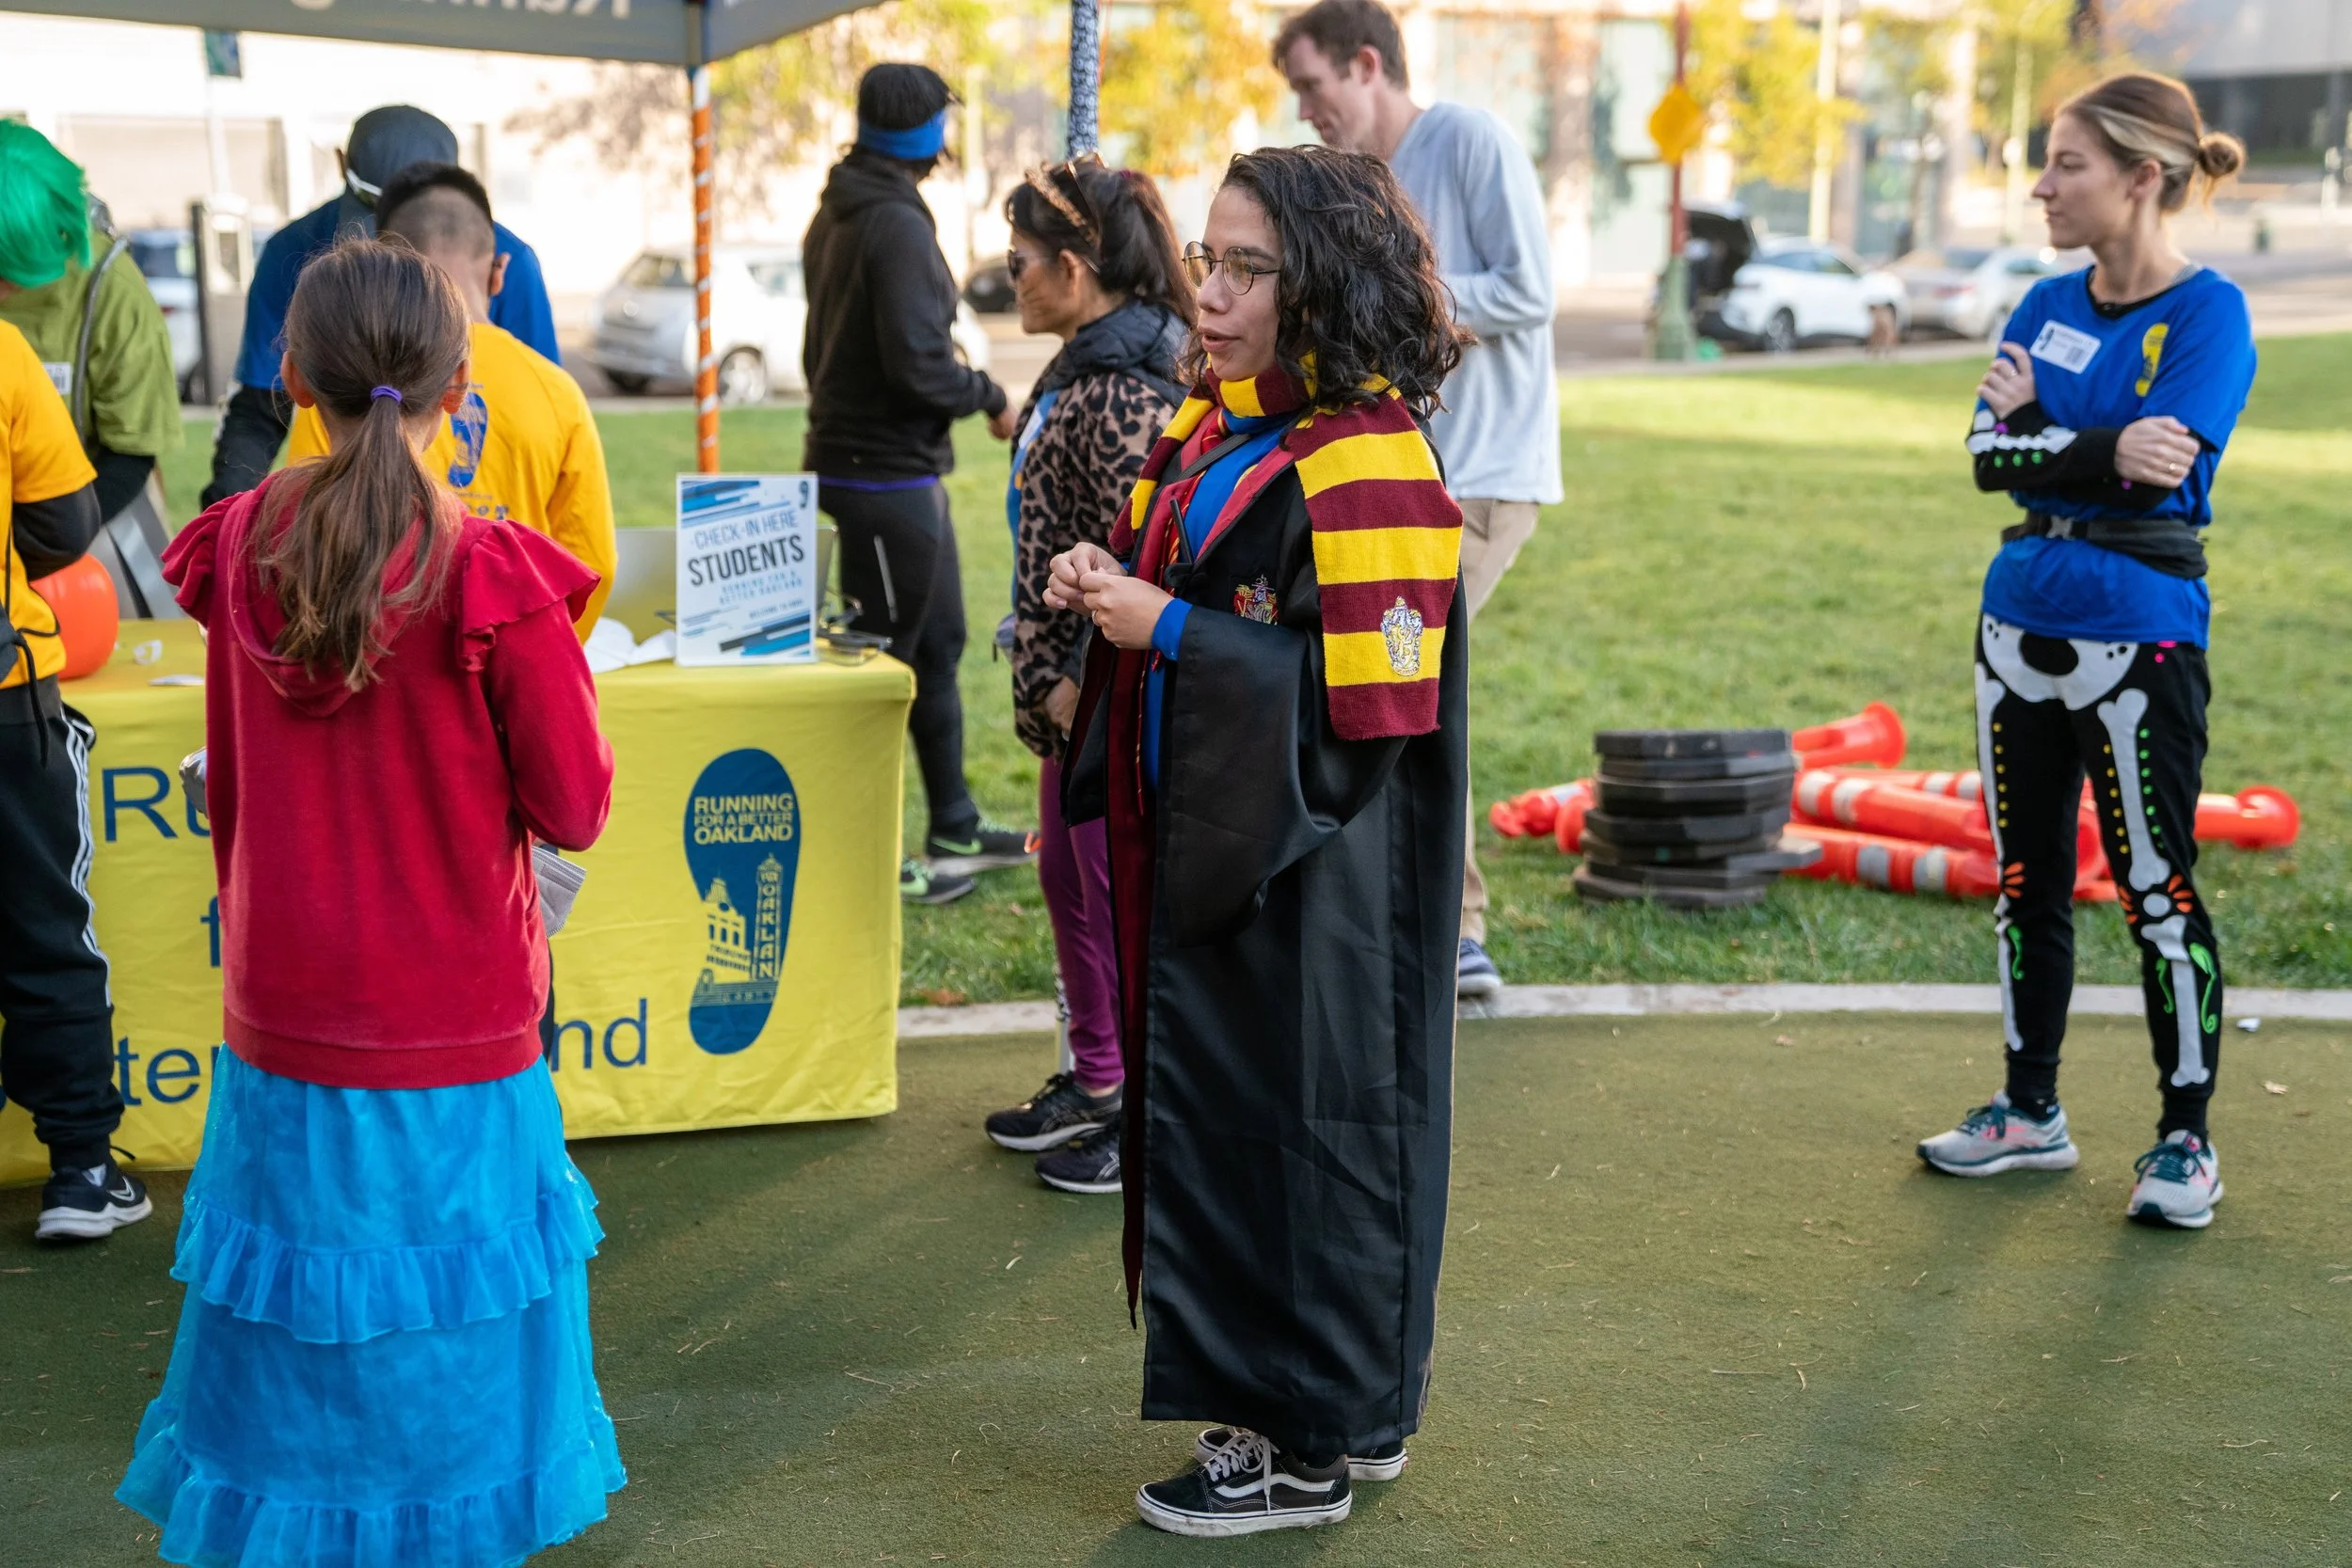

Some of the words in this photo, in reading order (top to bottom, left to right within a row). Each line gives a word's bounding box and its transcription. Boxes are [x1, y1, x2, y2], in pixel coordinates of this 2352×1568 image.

[693, 517, 761, 550] CHECK-IN
[763, 509, 798, 533] HERE
[688, 534, 805, 587] STUDENTS
[694, 793, 794, 815] RUNNING
[694, 815, 723, 828] FOR
[726, 813, 737, 827] A
[739, 811, 792, 826] BETTER
[693, 824, 793, 846] OAKLAND
